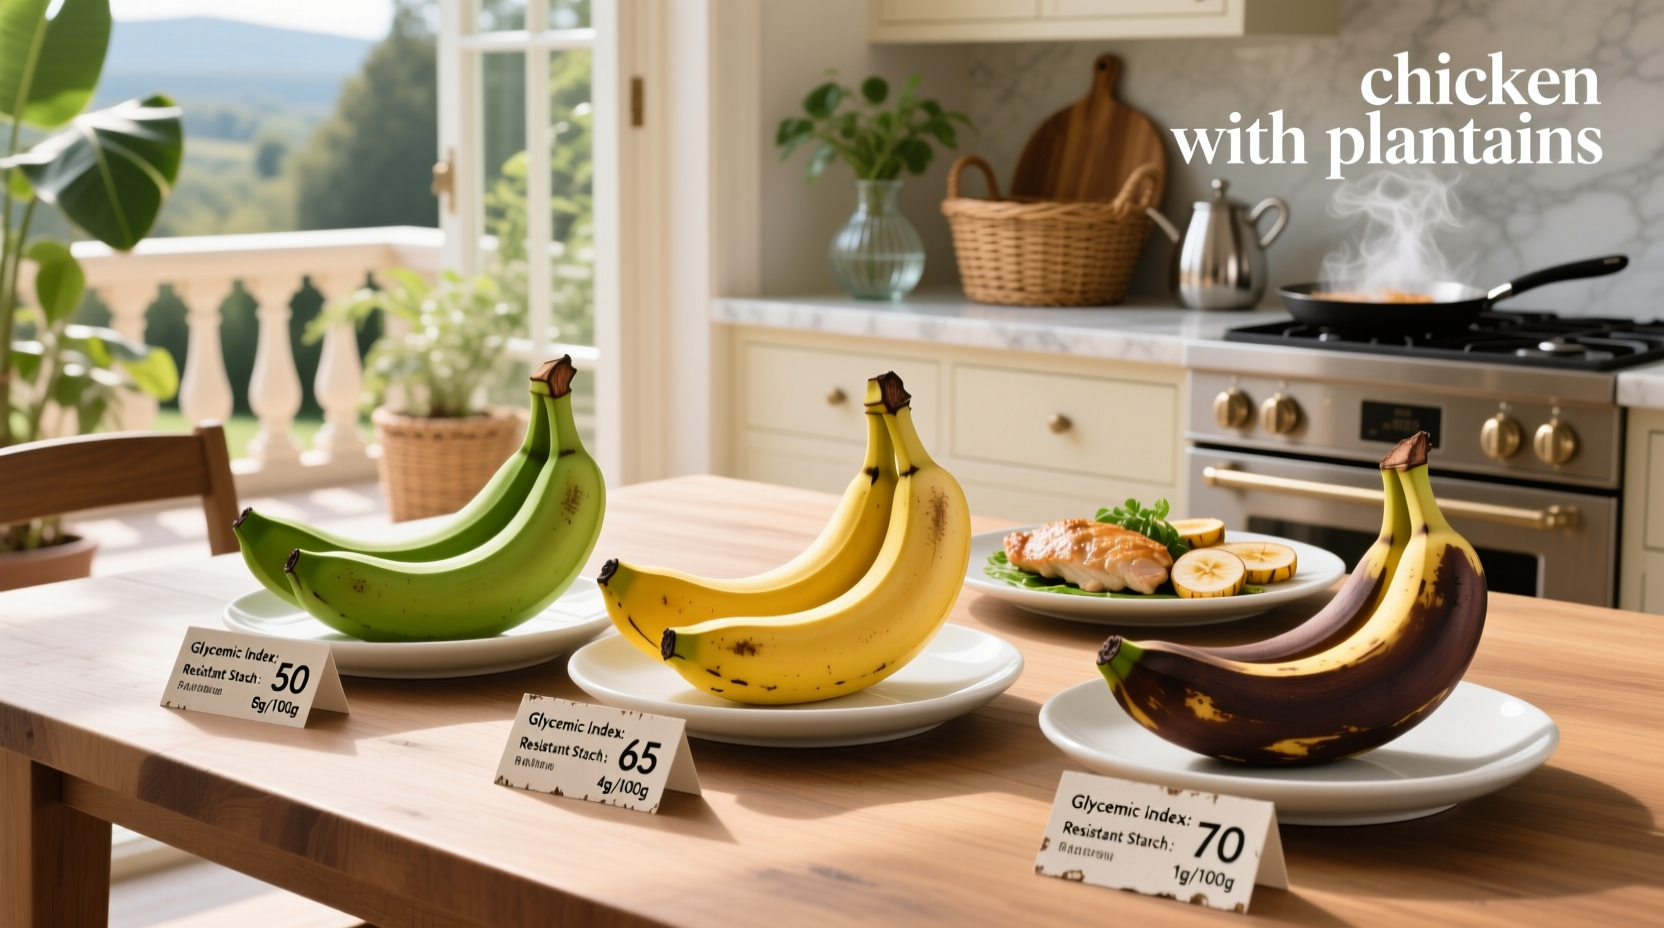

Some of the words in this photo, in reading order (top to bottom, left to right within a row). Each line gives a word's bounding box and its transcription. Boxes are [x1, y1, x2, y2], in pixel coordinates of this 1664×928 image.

[191, 641, 242, 658] Glycemic
[271, 663, 310, 694] 50
[529, 712, 584, 732] Glycemic
[588, 721, 625, 739] Index:
[619, 739, 661, 774] 65
[597, 776, 649, 800] 4g/100g
[1072, 795, 1141, 818] Glycemic
[1144, 805, 1192, 826] Index:
[1063, 821, 1124, 842] Resistant
[1127, 832, 1174, 852] Starch:
[1194, 822, 1245, 863] 70
[1174, 864, 1234, 892] 1g/100g
